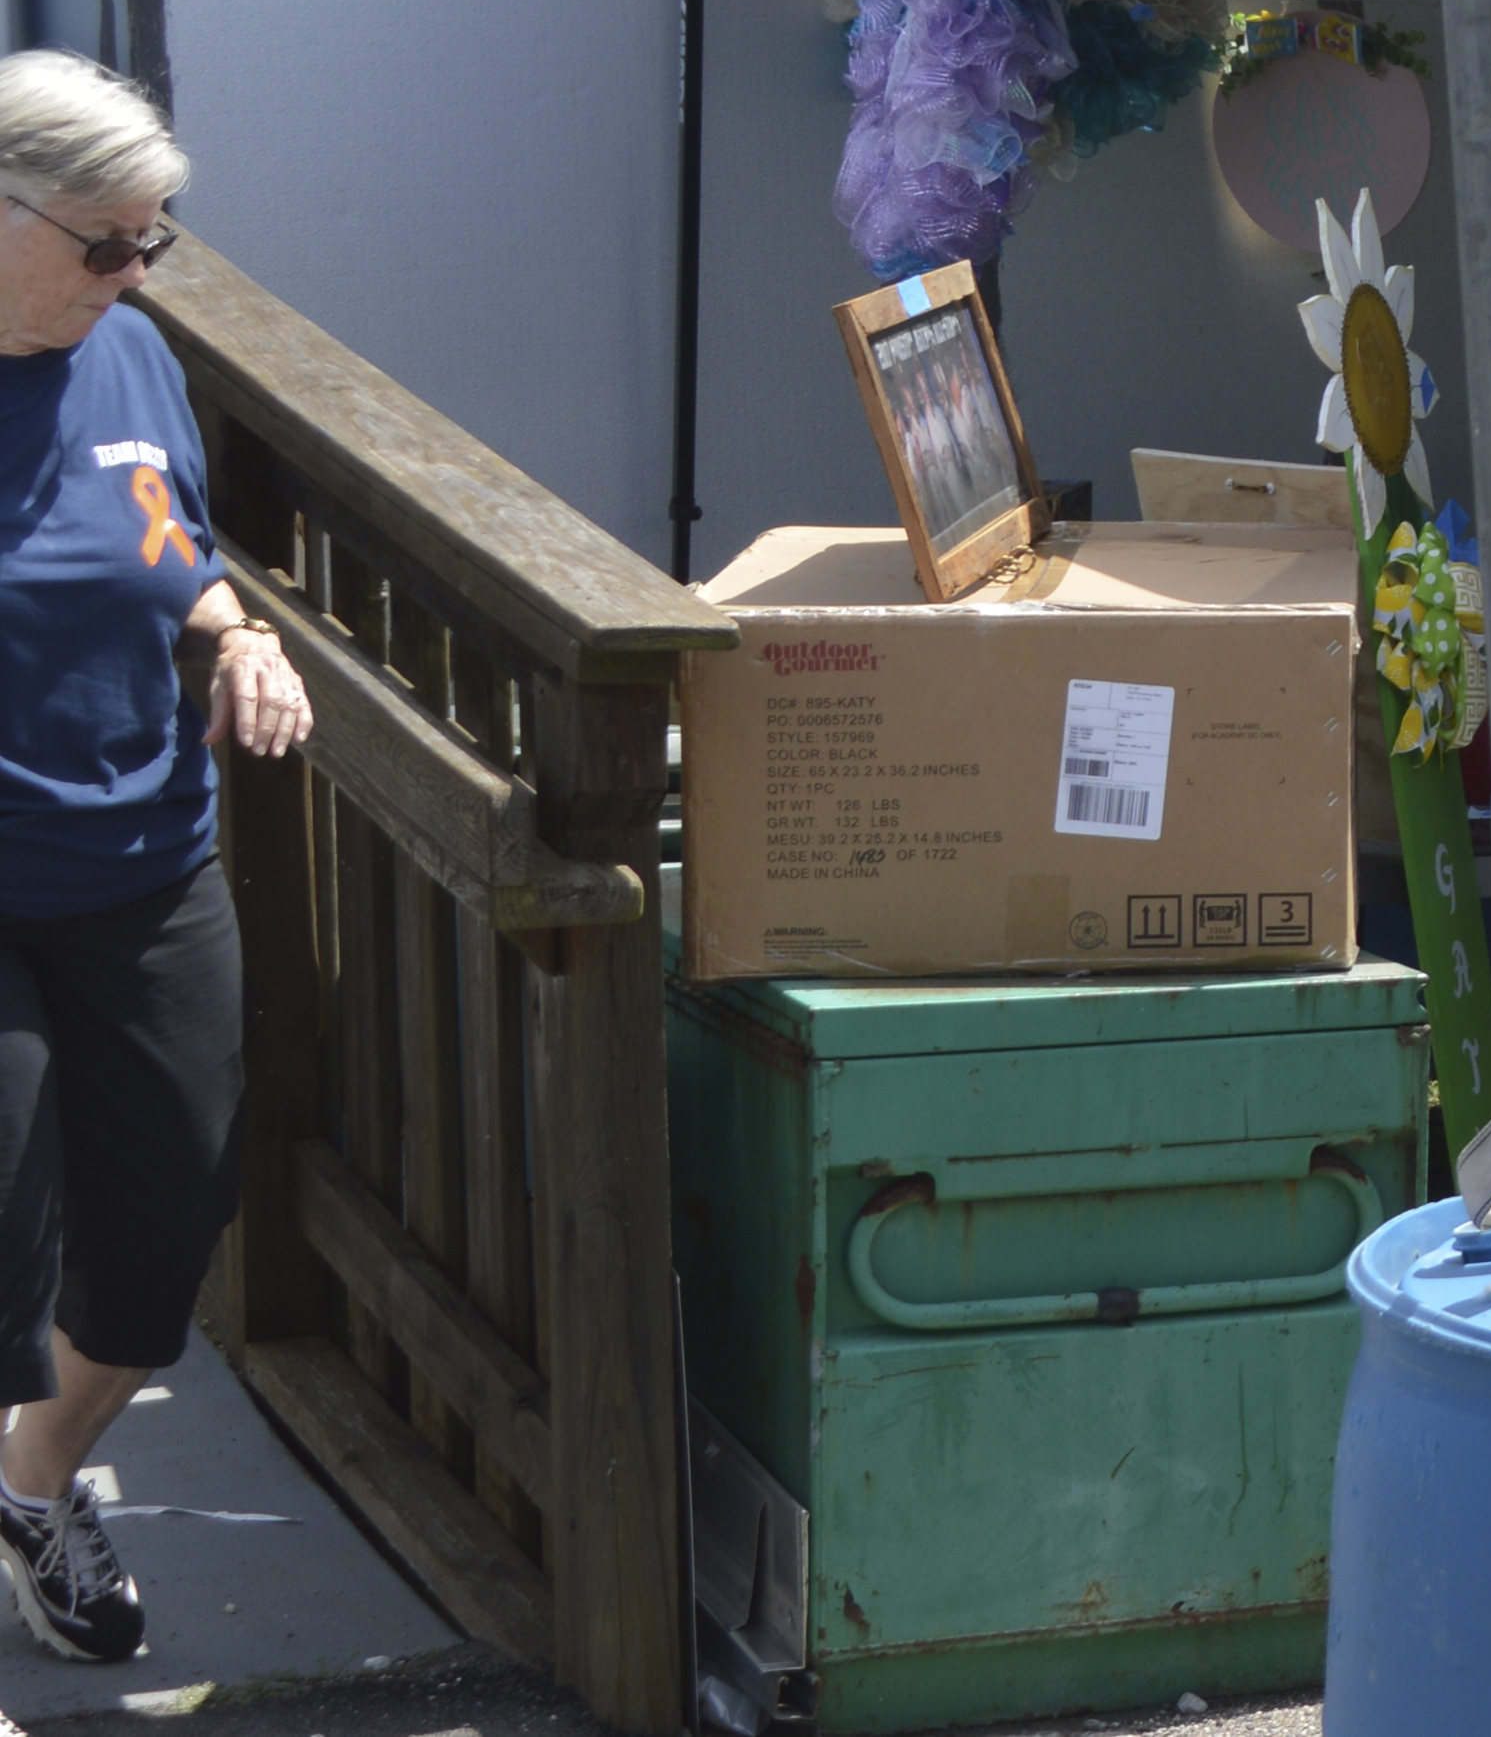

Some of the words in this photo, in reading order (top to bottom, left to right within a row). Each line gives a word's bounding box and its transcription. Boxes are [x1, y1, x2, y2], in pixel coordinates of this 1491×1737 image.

[763, 639, 873, 662] Outdoor
[806, 697, 877, 709] 895-KATY
[767, 715, 793, 727] PO:
[797, 714, 884, 726] 0006572576
[767, 732, 819, 744] STYLE:
[824, 731, 875, 743] 157969
[767, 749, 824, 761] COLOR:
[829, 748, 878, 760] BLACK
[767, 766, 805, 778] SIZE:
[809, 765, 826, 777] 65
[830, 766, 840, 777] X
[843, 765, 872, 777] 23.2
[876, 765, 886, 776] X
[890, 764, 920, 776] 36.2
[923, 763, 980, 776] INCHES
[767, 783, 801, 795] QTY:
[806, 783, 835, 794] 1PC
[767, 800, 788, 811] NT
[790, 800, 816, 811] WT:
[836, 799, 861, 811] 126
[872, 799, 900, 810] LBS
[767, 817, 788, 829] GR
[835, 816, 860, 828] 132
[871, 816, 899, 827] LBS
[767, 834, 814, 846] MESU:
[819, 834, 849, 845] 39.2
[852, 834, 862, 845] X
[865, 833, 896, 845] 25.2
[899, 833, 908, 844] X
[914, 832, 943, 844] 14.8
[946, 831, 1003, 844] INCHES
[767, 851, 807, 862] CASE
[811, 850, 838, 862] NO:
[896, 849, 918, 861] OF
[924, 848, 957, 860] 1722
[767, 868, 809, 879] MADE
[814, 868, 829, 879] IN
[832, 867, 880, 879] CHINA
[1279, 900, 1295, 923] 3
[773, 927, 829, 937] WARNING:
